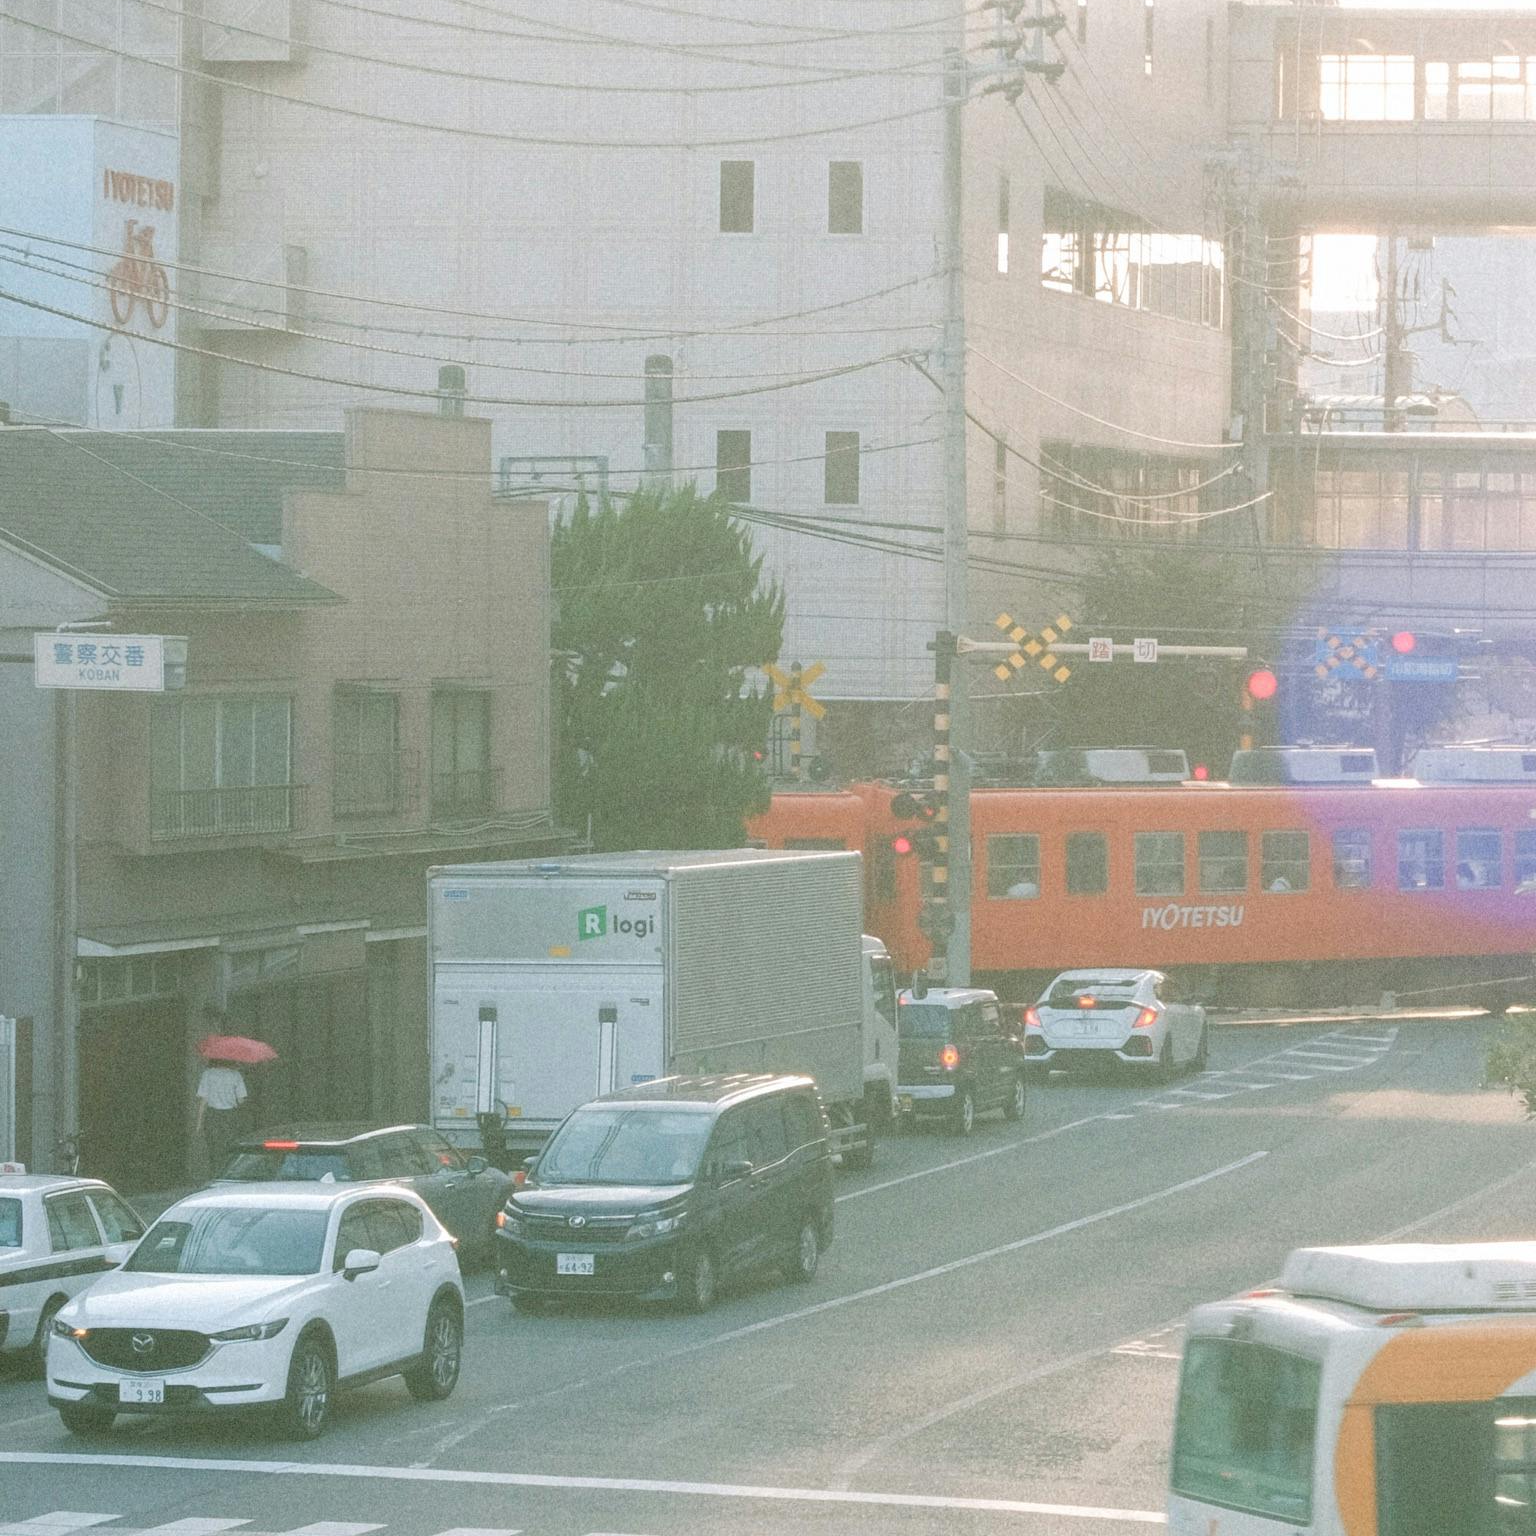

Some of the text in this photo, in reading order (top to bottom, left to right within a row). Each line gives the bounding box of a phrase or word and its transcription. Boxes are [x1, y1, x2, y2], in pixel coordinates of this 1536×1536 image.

[54, 643, 145, 667] 警察交番
[79, 669, 120, 681] KOBAN
[613, 915, 655, 938] logi
[1142, 904, 1245, 930] IYOTETSU
